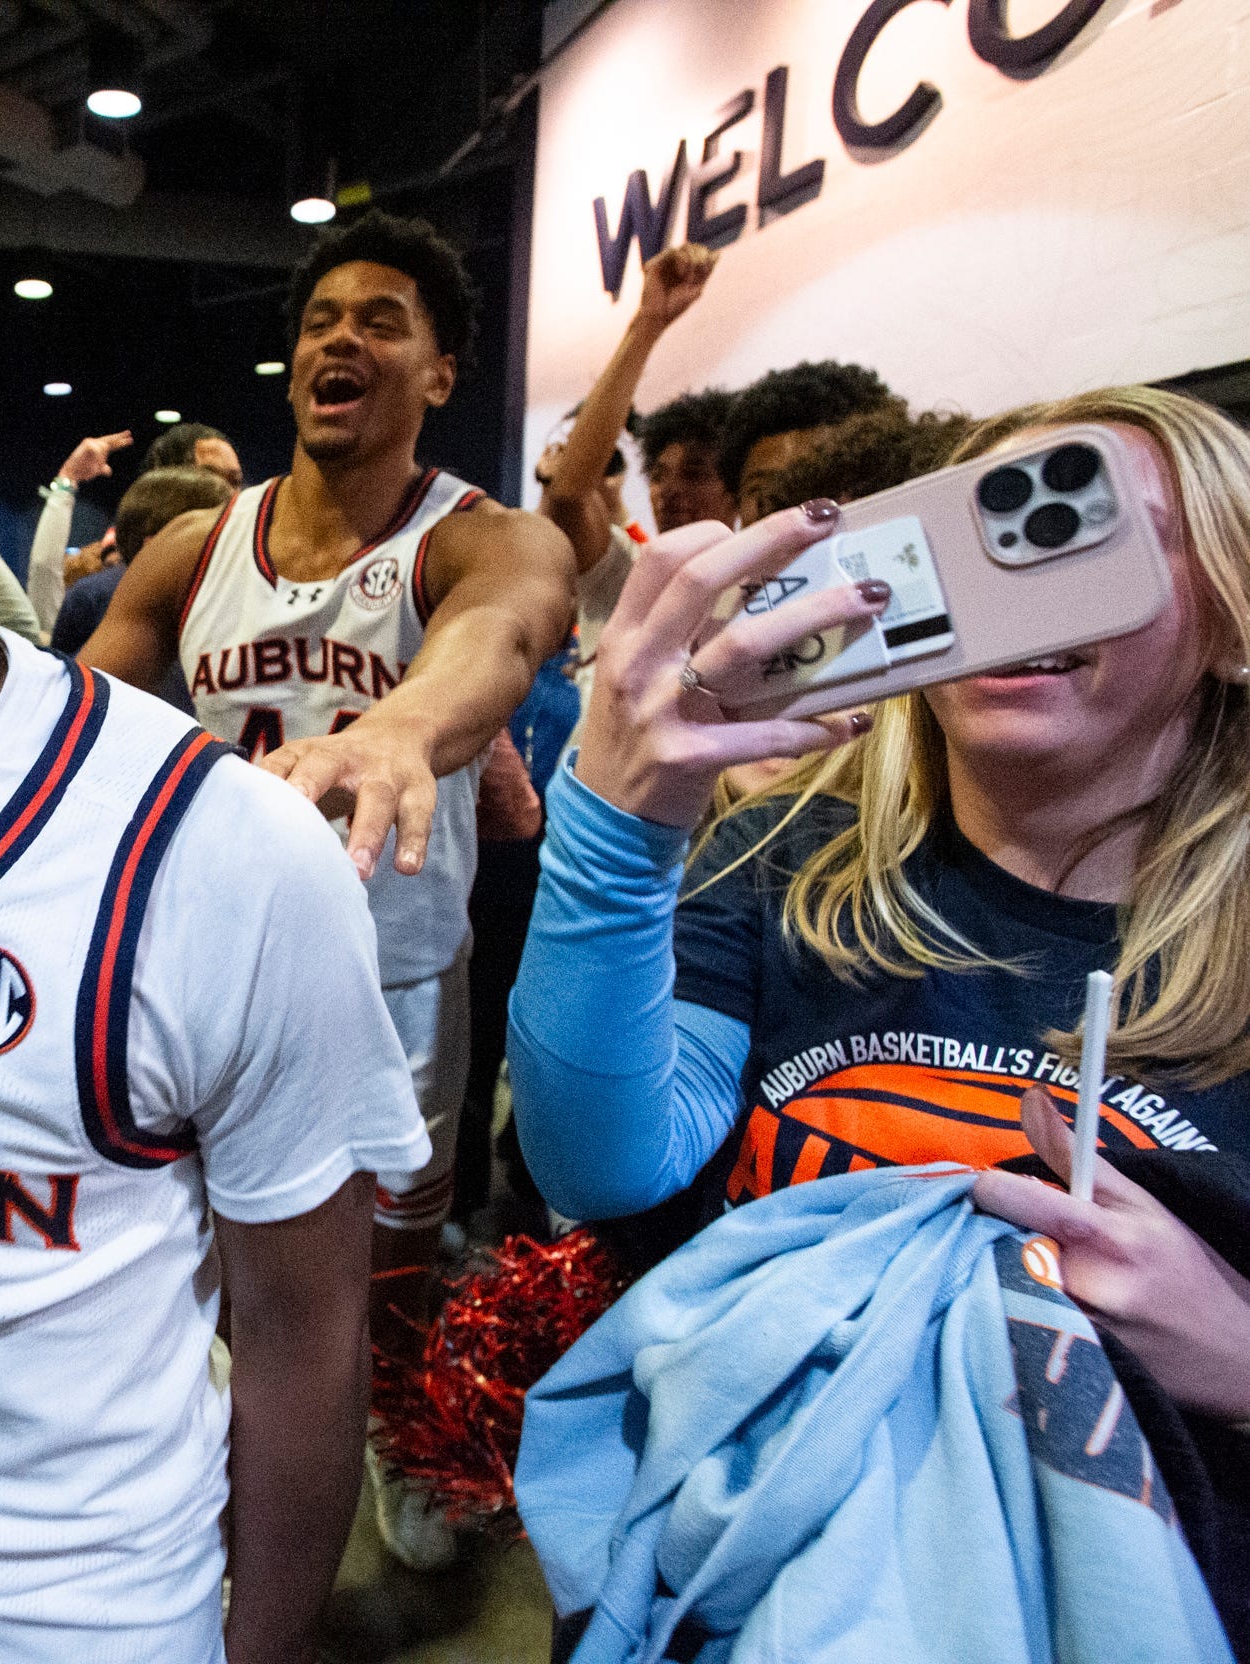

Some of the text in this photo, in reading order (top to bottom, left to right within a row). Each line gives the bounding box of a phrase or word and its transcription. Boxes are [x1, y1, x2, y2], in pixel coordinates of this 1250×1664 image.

[192, 637, 408, 700] AUBURN
[759, 1031, 1219, 1151] AUBURN BASKETBALL'S FIGT AGAIN
